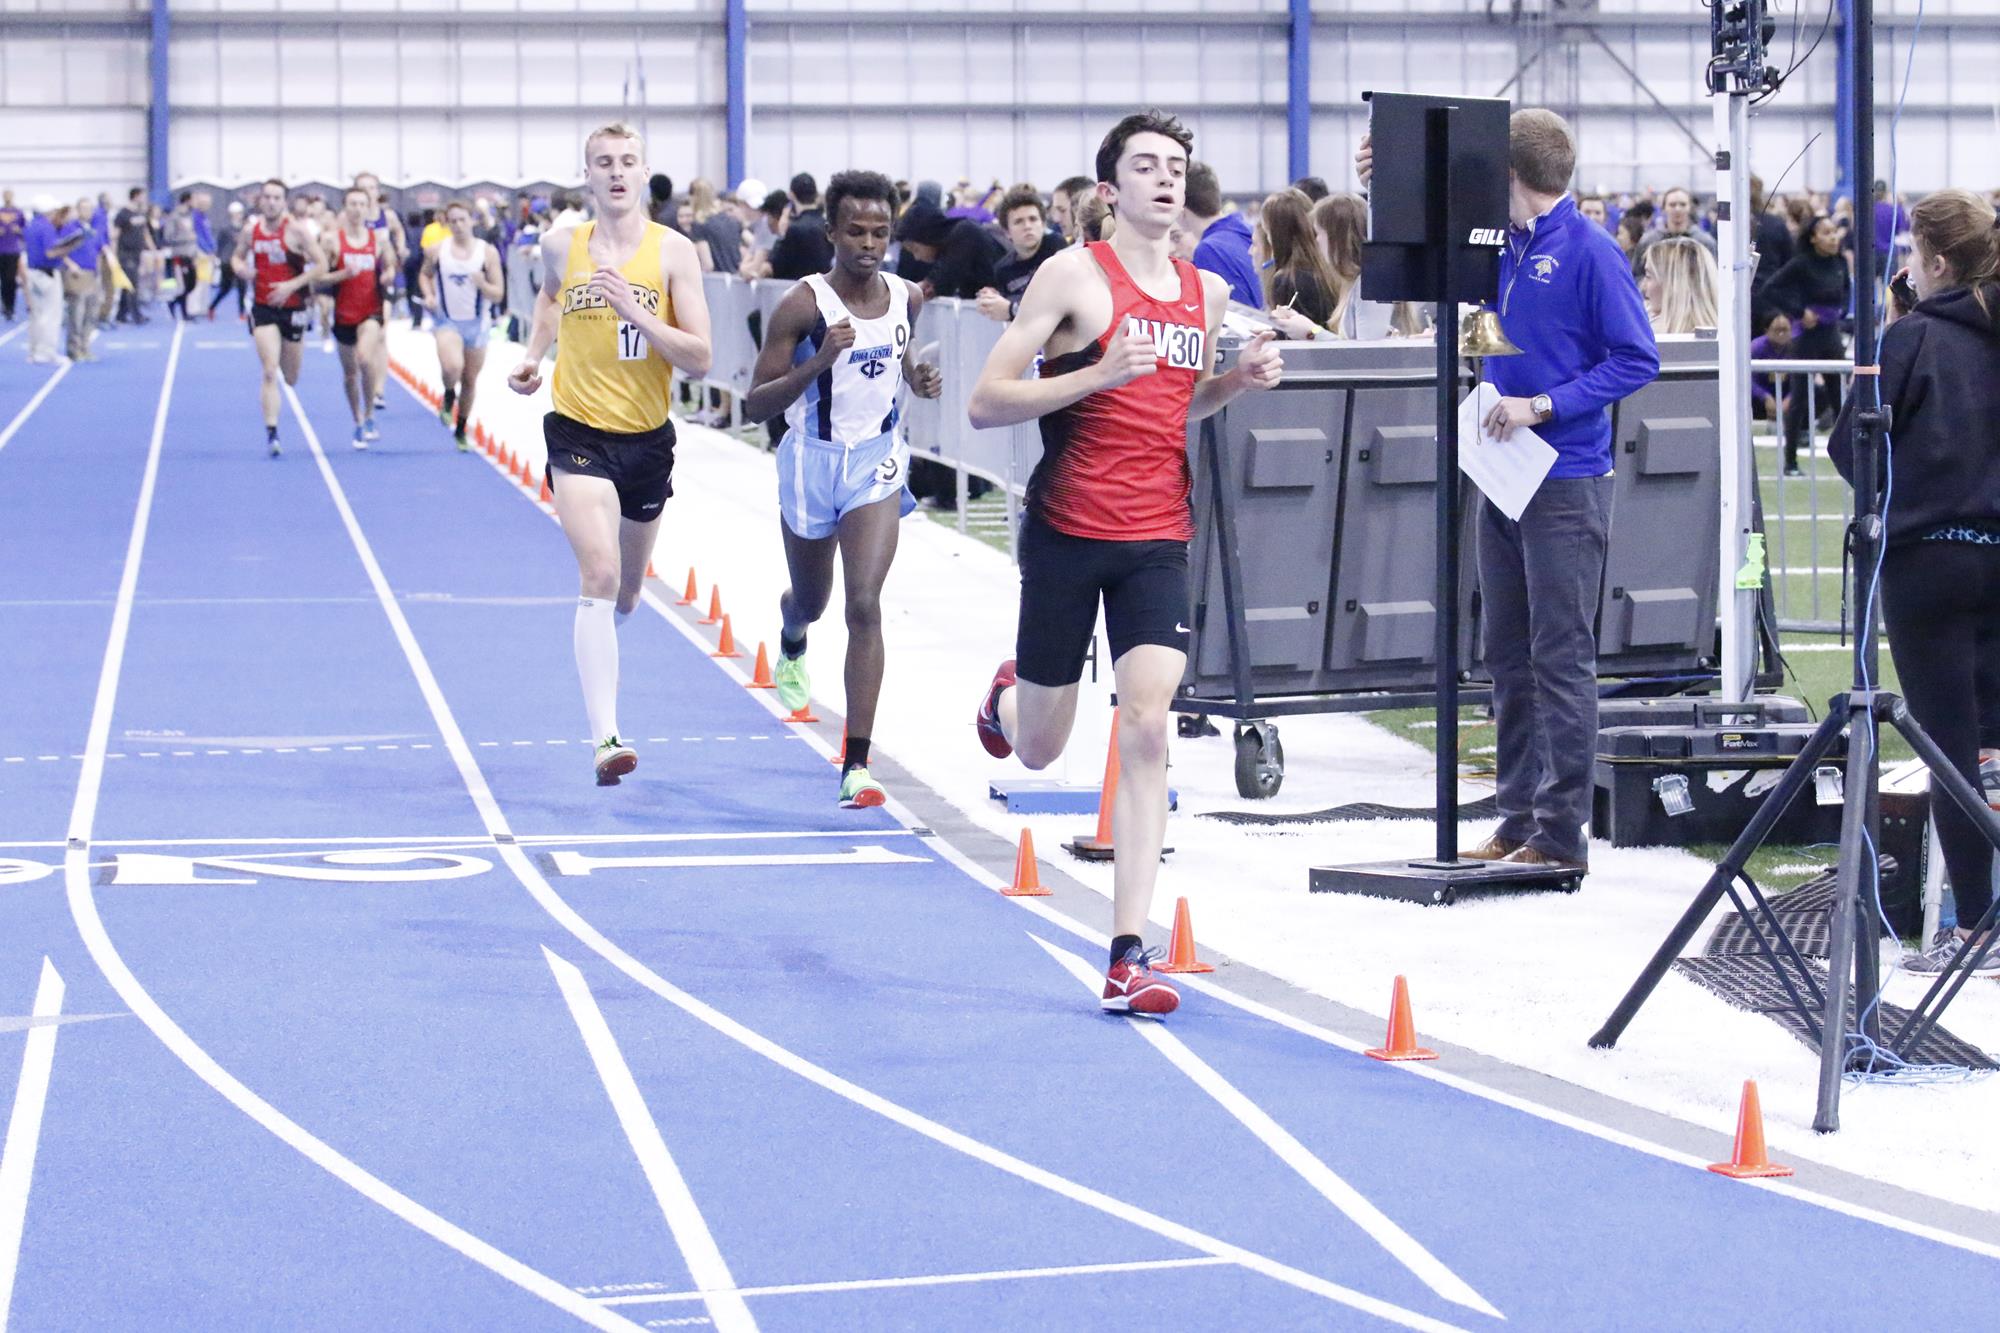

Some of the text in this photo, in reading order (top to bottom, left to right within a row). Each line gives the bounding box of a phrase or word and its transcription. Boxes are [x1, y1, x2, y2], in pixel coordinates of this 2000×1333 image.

[1468, 228, 1505, 246] GILL
[563, 283, 660, 316] DEFEERS
[620, 323, 641, 358] 17
[869, 347, 893, 360] CENTRA
[895, 324, 906, 360] 9
[1171, 330, 1200, 367] 30
[881, 458, 898, 480] 9
[1723, 739, 1759, 748] FatMax
[112, 851, 495, 884] 2
[551, 846, 933, 876] 1
